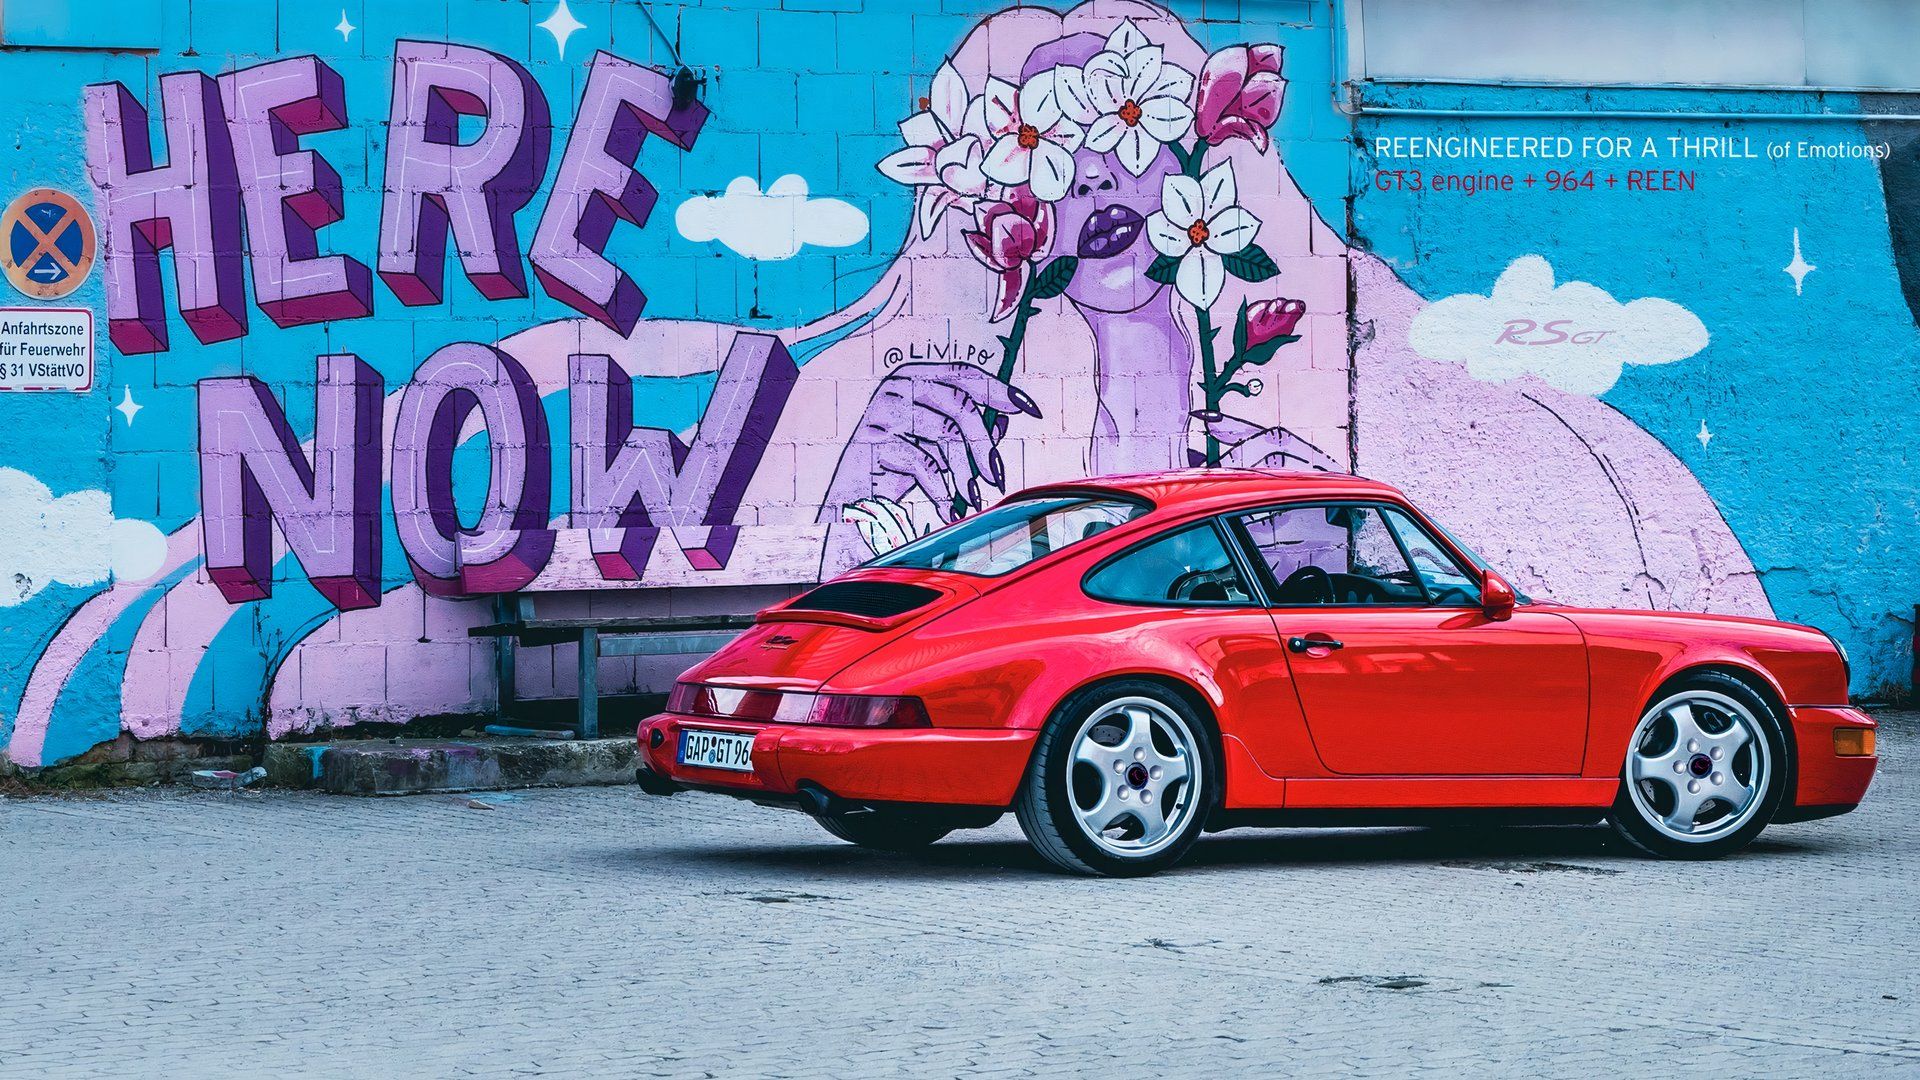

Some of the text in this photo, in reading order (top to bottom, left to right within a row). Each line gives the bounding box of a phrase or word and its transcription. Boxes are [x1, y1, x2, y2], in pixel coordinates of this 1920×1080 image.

[84, 38, 711, 355] HERE
[1, 321, 84, 335] Anfahrtszone
[0, 342, 86, 356] für Feuerwehr
[10, 363, 24, 377] 31
[28, 363, 84, 377] VStättVO
[197, 331, 800, 610] NOW
[686, 735, 753, 766] GAP GT 96
